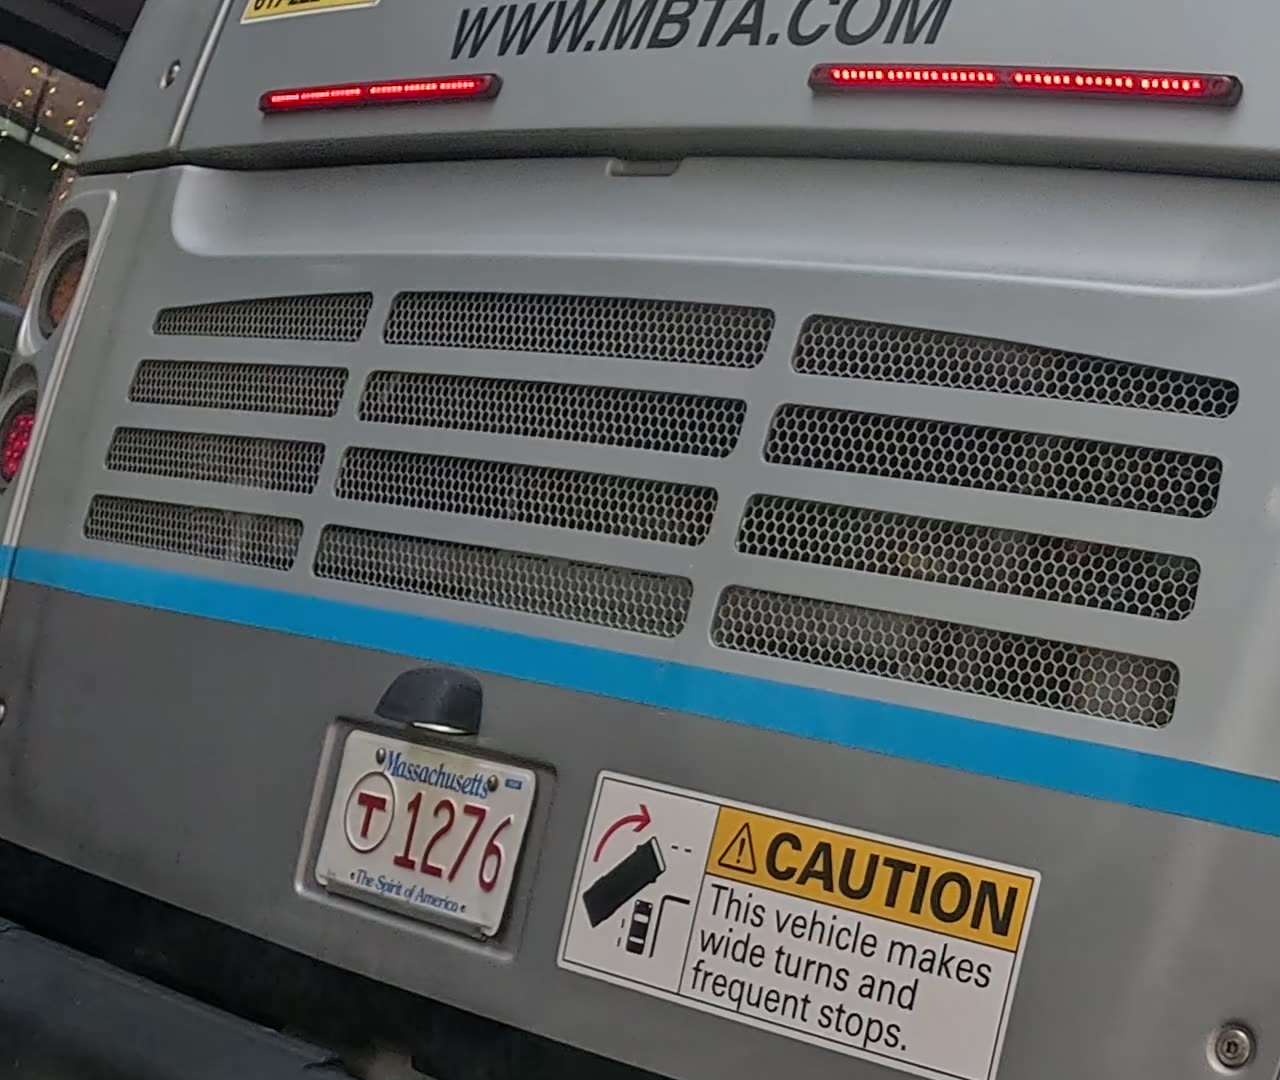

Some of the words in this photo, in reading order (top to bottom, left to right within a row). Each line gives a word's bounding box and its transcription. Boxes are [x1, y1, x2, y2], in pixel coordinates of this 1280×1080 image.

[450, 0, 953, 60] WWW.MBTA.COM
[384, 750, 490, 799] Massachusetts
[393, 791, 513, 893] 1276
[765, 831, 1019, 937] CAUTION
[356, 869, 374, 886] The
[375, 875, 402, 896] Spirit
[404, 885, 417, 902] of
[415, 888, 458, 912] America
[700, 927, 767, 969] wide
[773, 945, 850, 992] turns
[858, 972, 919, 1011] and
[711, 883, 766, 929] This
[775, 908, 878, 958] vehicle
[886, 939, 993, 989] makes
[691, 960, 812, 1022] frequent
[817, 1003, 907, 1051] stops.
